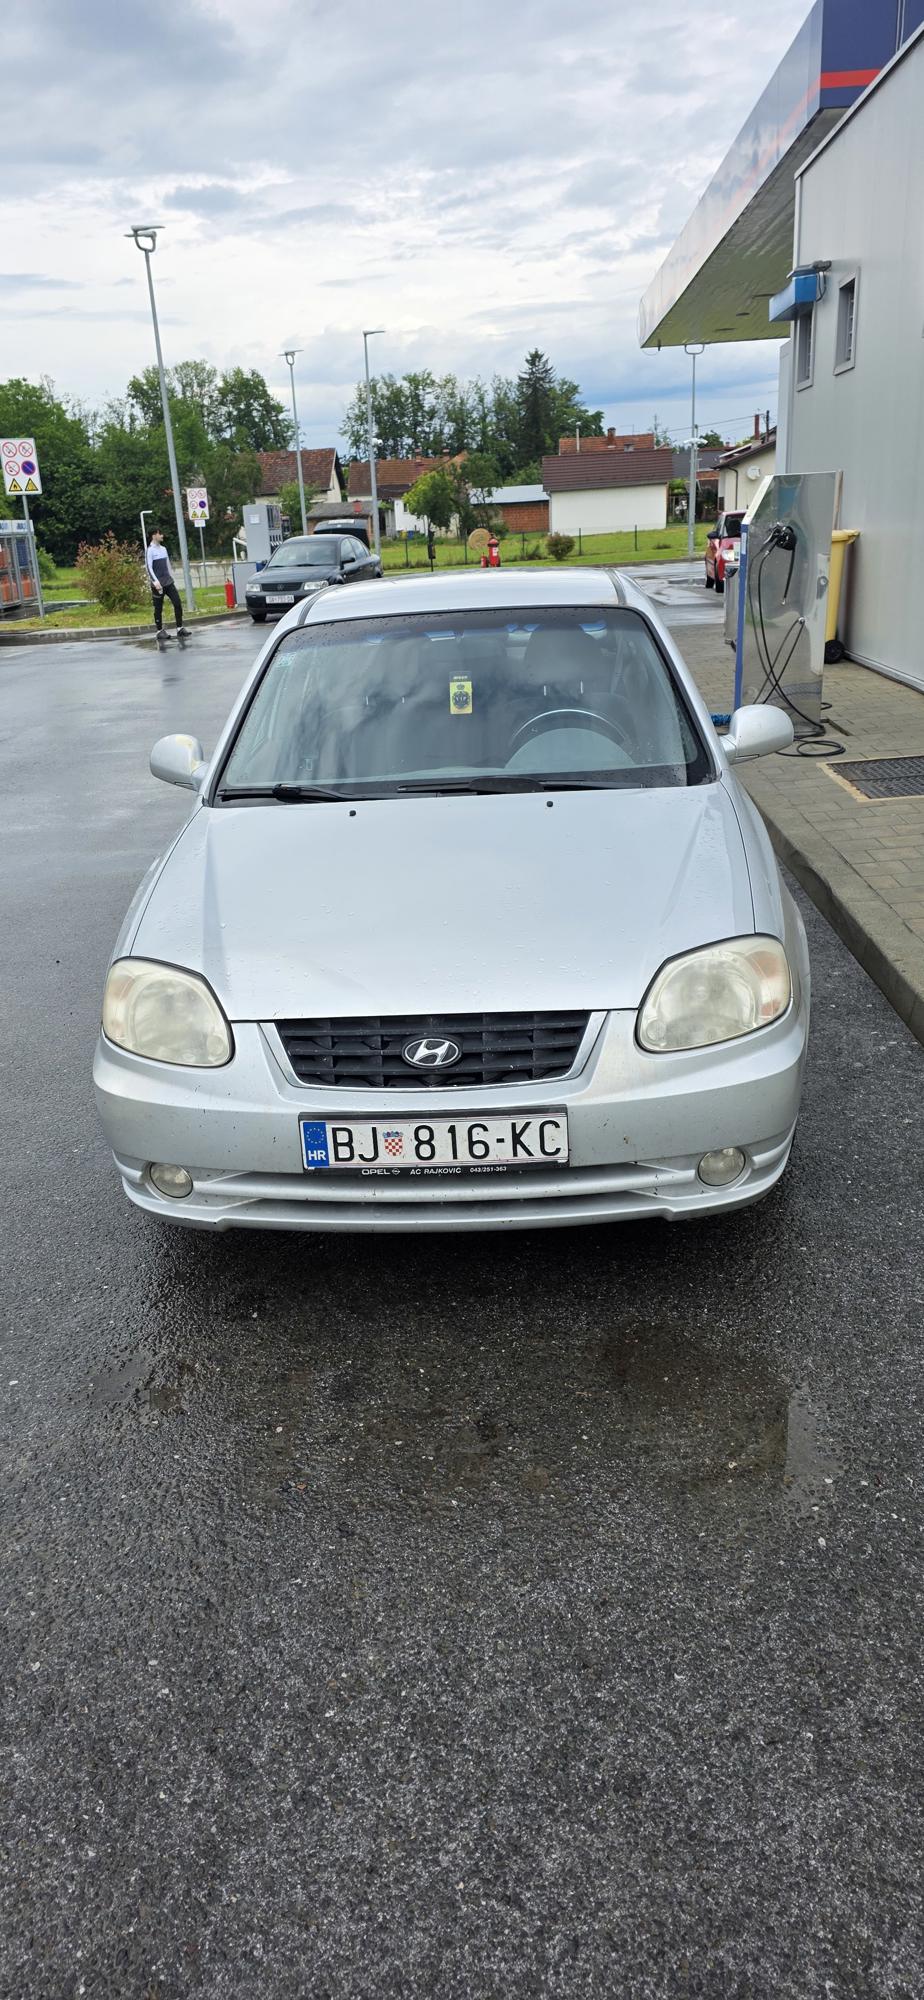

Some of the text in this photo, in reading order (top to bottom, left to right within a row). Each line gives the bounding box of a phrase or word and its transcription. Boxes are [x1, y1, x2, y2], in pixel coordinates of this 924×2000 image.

[331, 1119, 562, 1163] BJ 816-KC
[307, 1150, 327, 1161] HR
